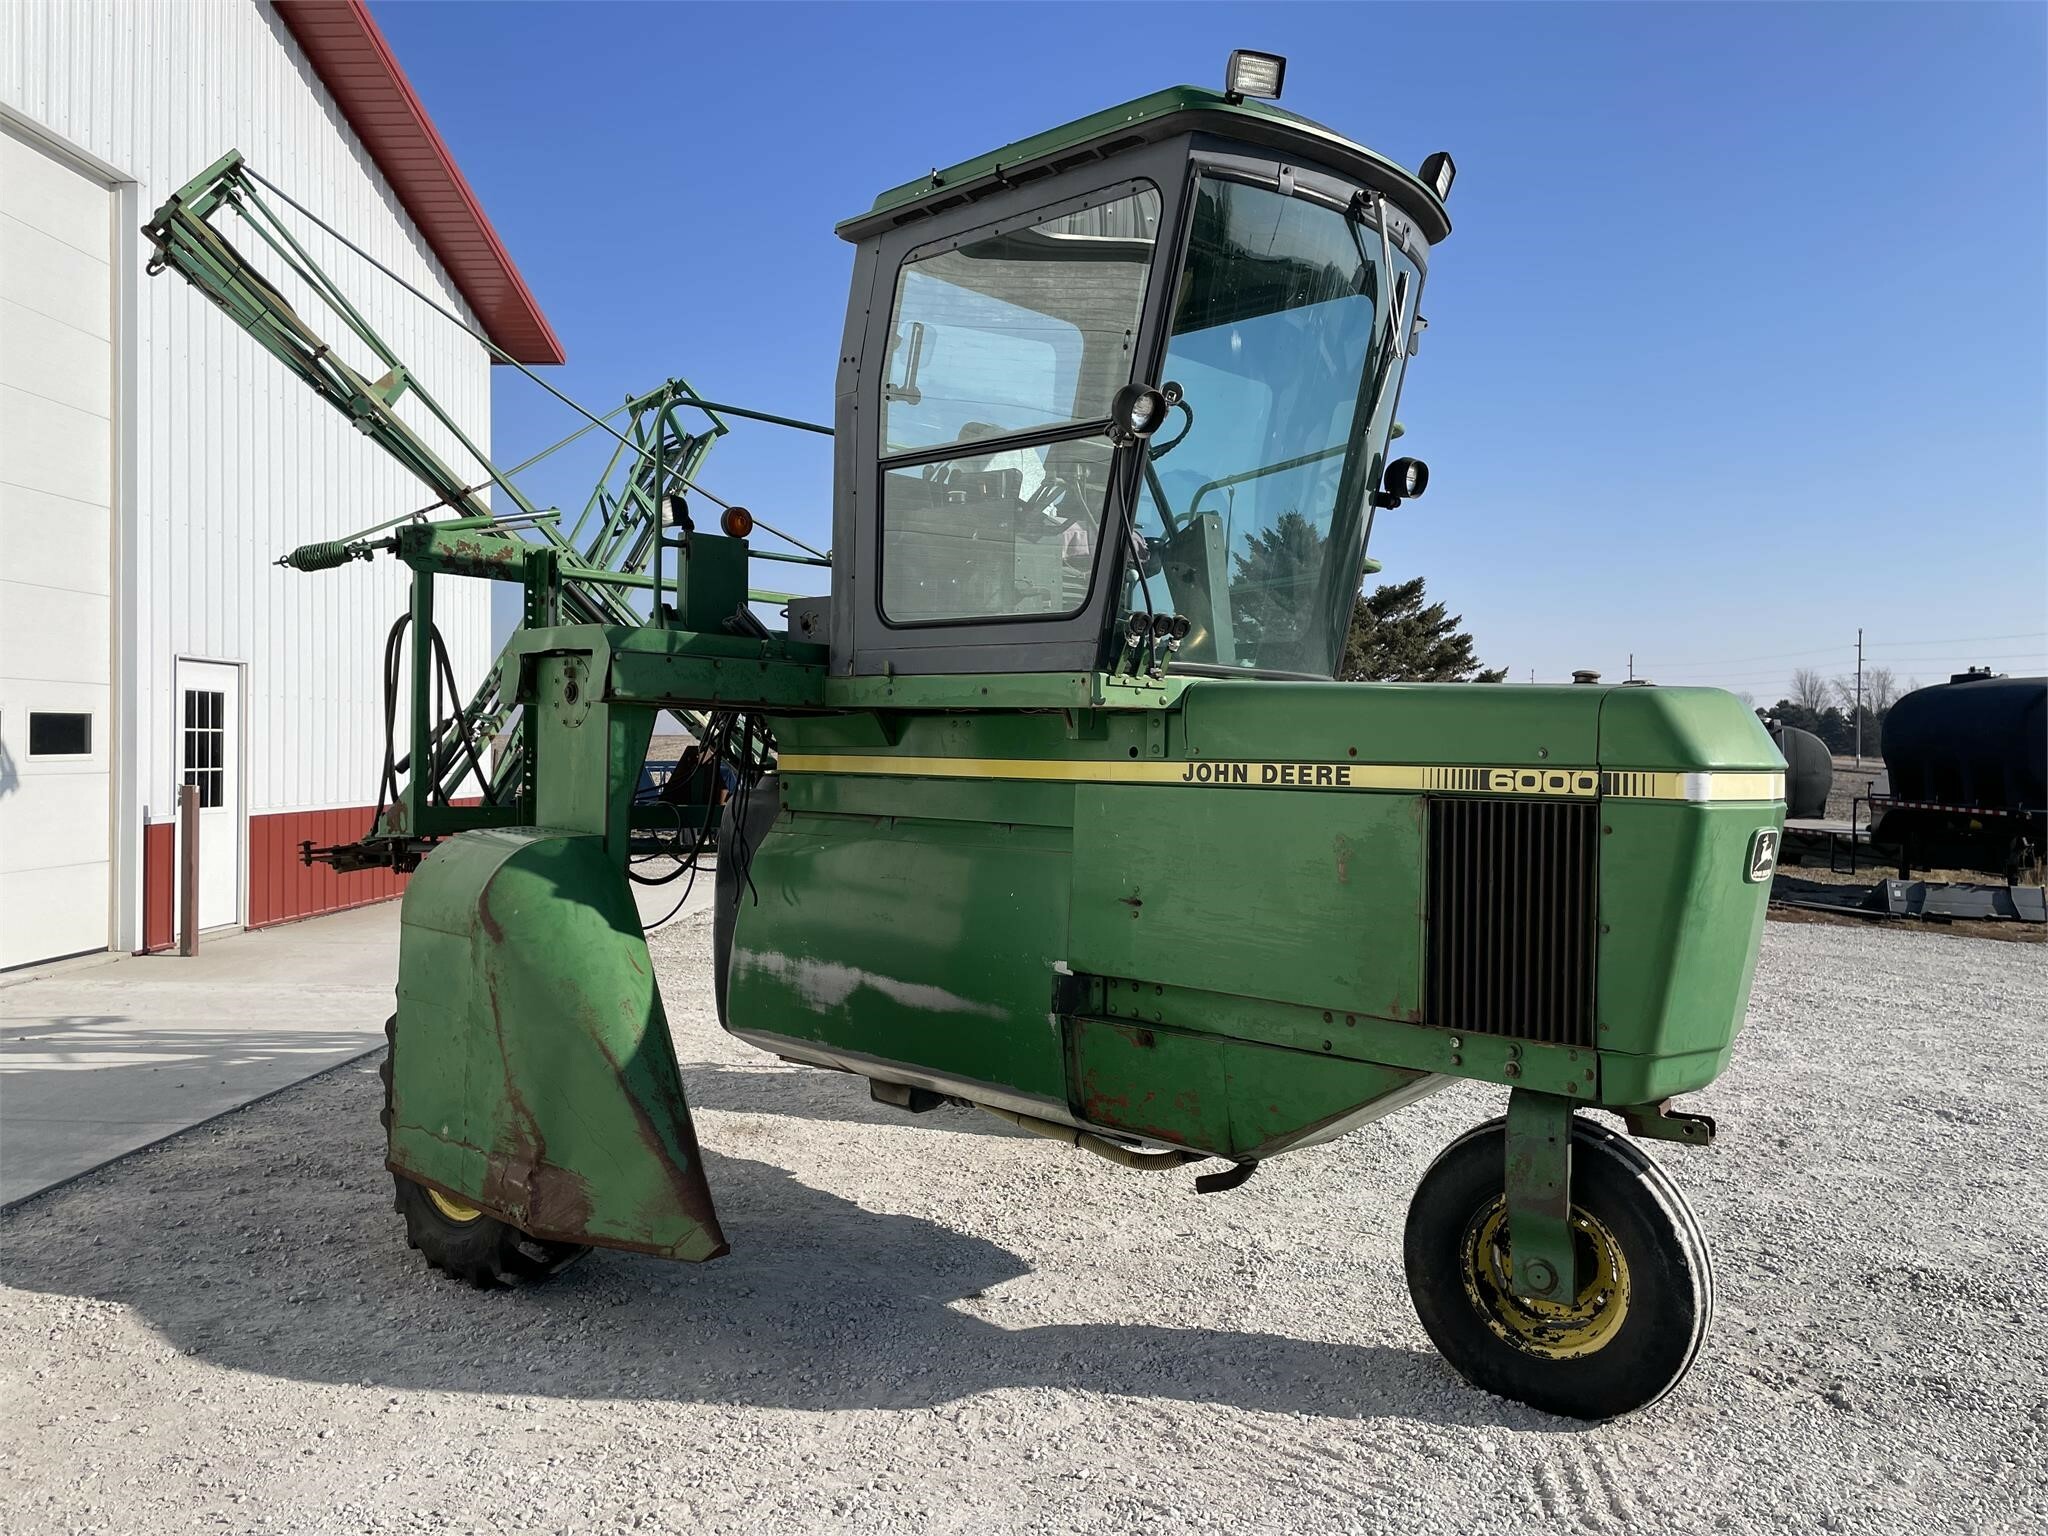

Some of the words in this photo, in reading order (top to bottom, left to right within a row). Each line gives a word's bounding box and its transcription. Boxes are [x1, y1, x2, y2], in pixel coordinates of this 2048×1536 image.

[1182, 763, 1248, 783] JOHN
[1261, 764, 1351, 786] DEERE
[1488, 769, 1599, 796] 6000
